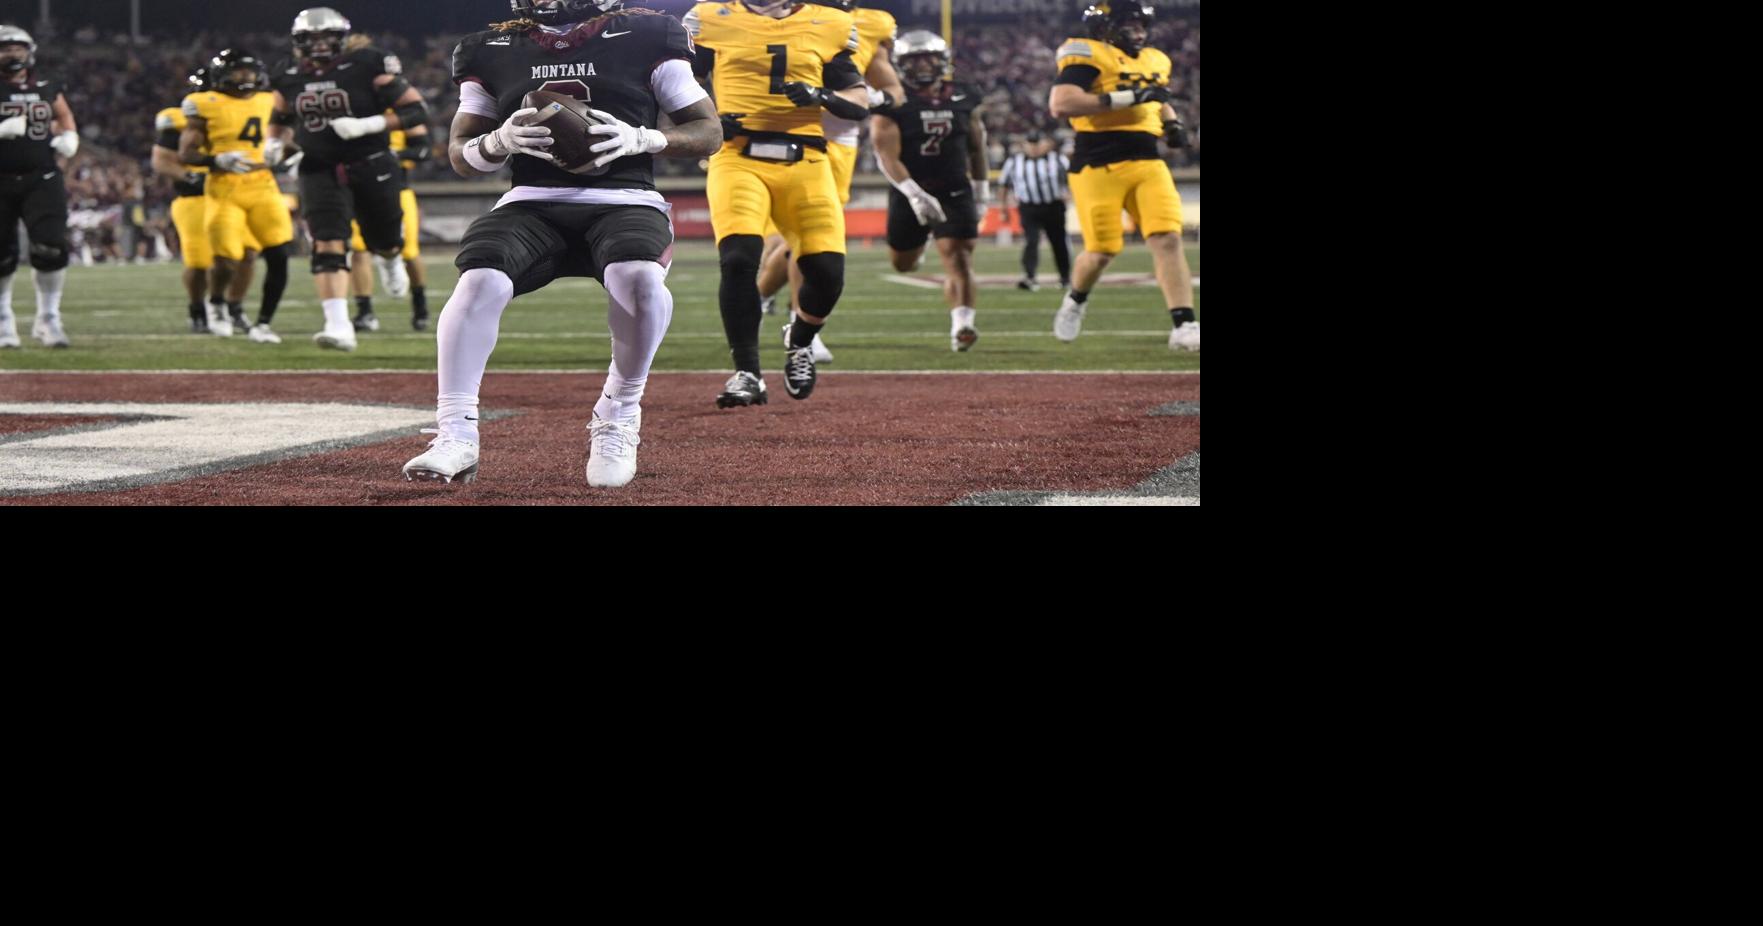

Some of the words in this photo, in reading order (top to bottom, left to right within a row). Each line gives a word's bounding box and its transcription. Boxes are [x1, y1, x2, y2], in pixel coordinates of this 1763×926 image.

[531, 62, 597, 79] MONTANA
[766, 44, 788, 95] 1
[237, 117, 263, 149] 4
[920, 119, 953, 156] 7
